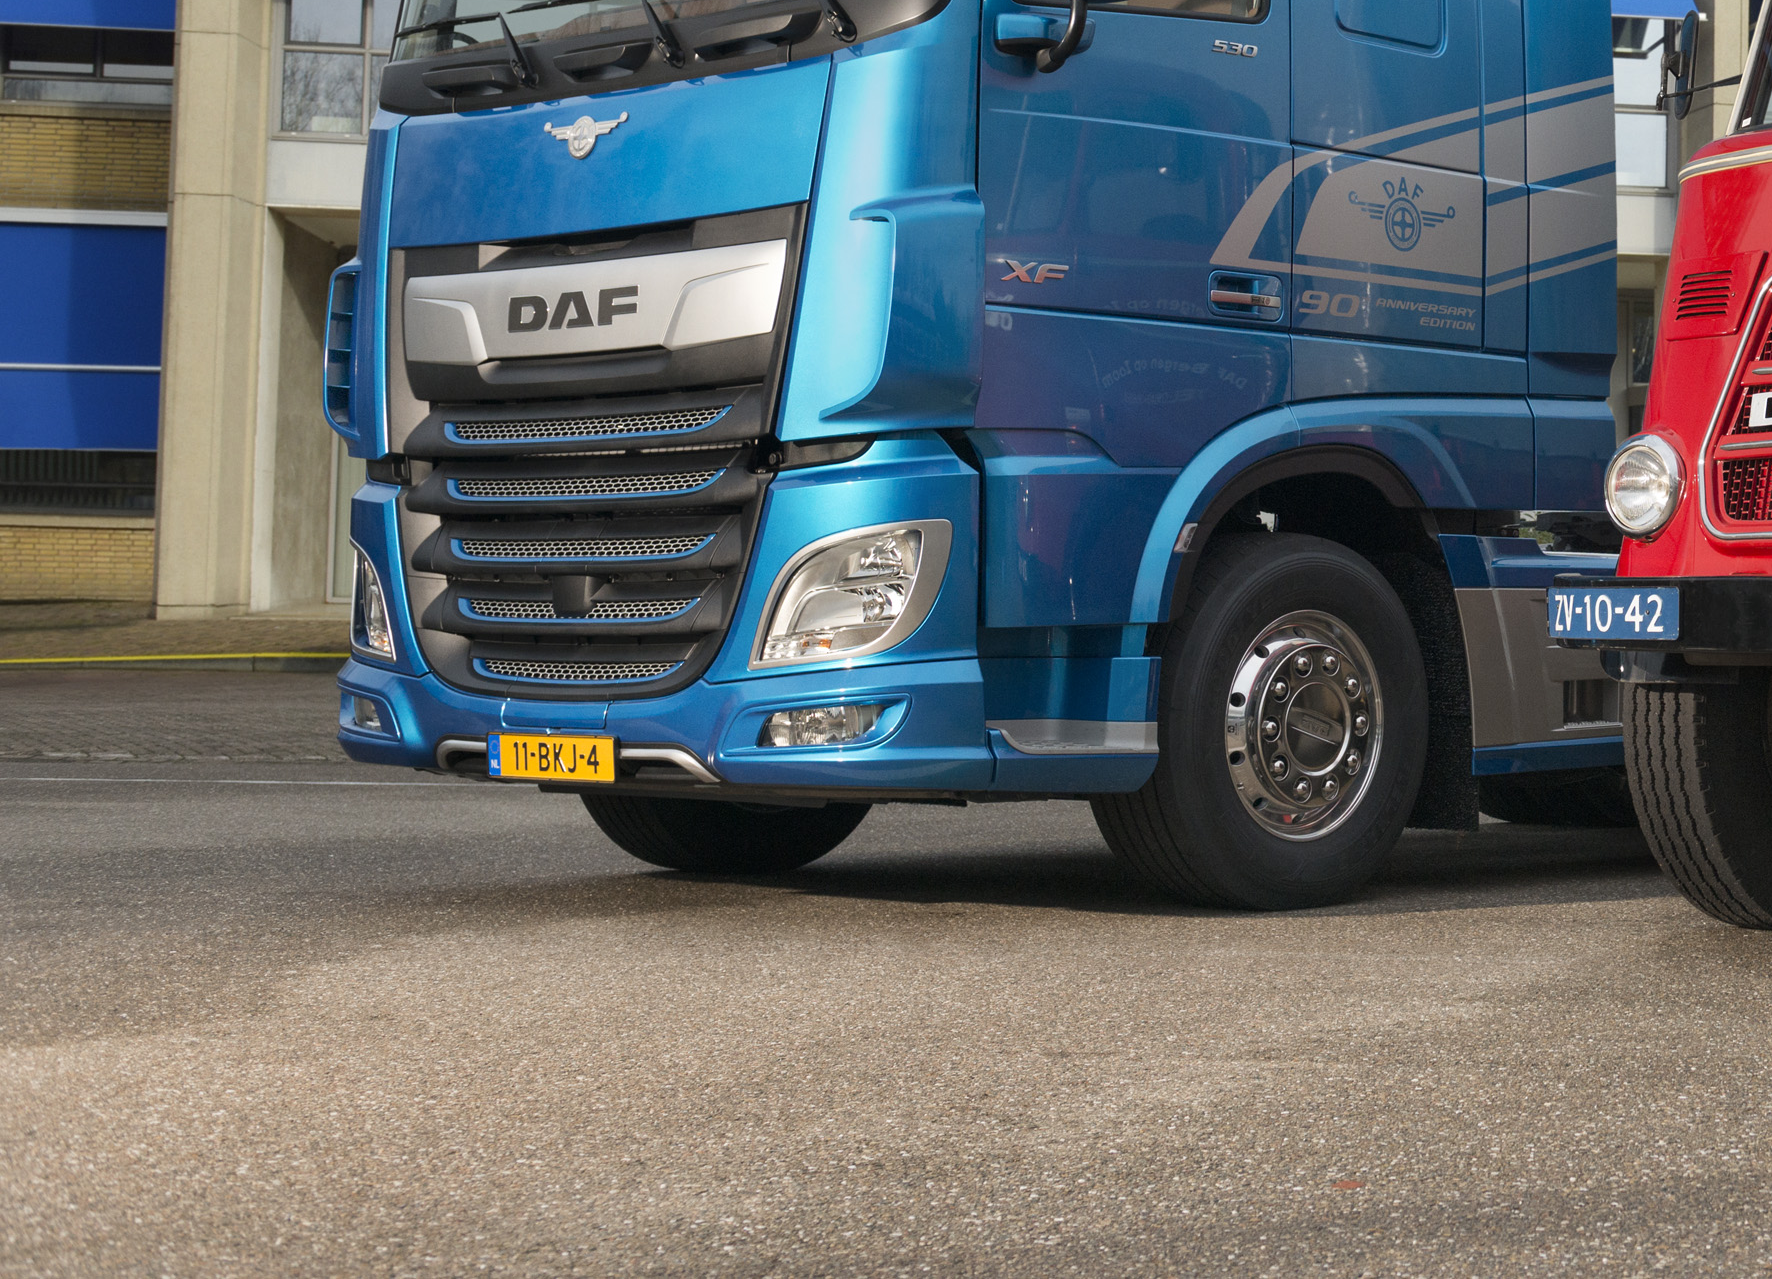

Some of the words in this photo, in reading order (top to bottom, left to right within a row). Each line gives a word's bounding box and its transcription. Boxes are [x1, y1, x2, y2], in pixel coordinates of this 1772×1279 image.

[1212, 39, 1258, 58] 530
[1382, 176, 1424, 201] DAF
[1001, 260, 1069, 284] XF
[508, 285, 640, 334] DAF
[1299, 290, 1360, 319] 90
[1376, 298, 1477, 318] ANNIVERSARY
[1419, 316, 1476, 331] EDITION
[1554, 594, 1664, 633] ZV-10-42
[491, 759, 500, 769] NL
[513, 741, 599, 774] 11-BKJ-4
